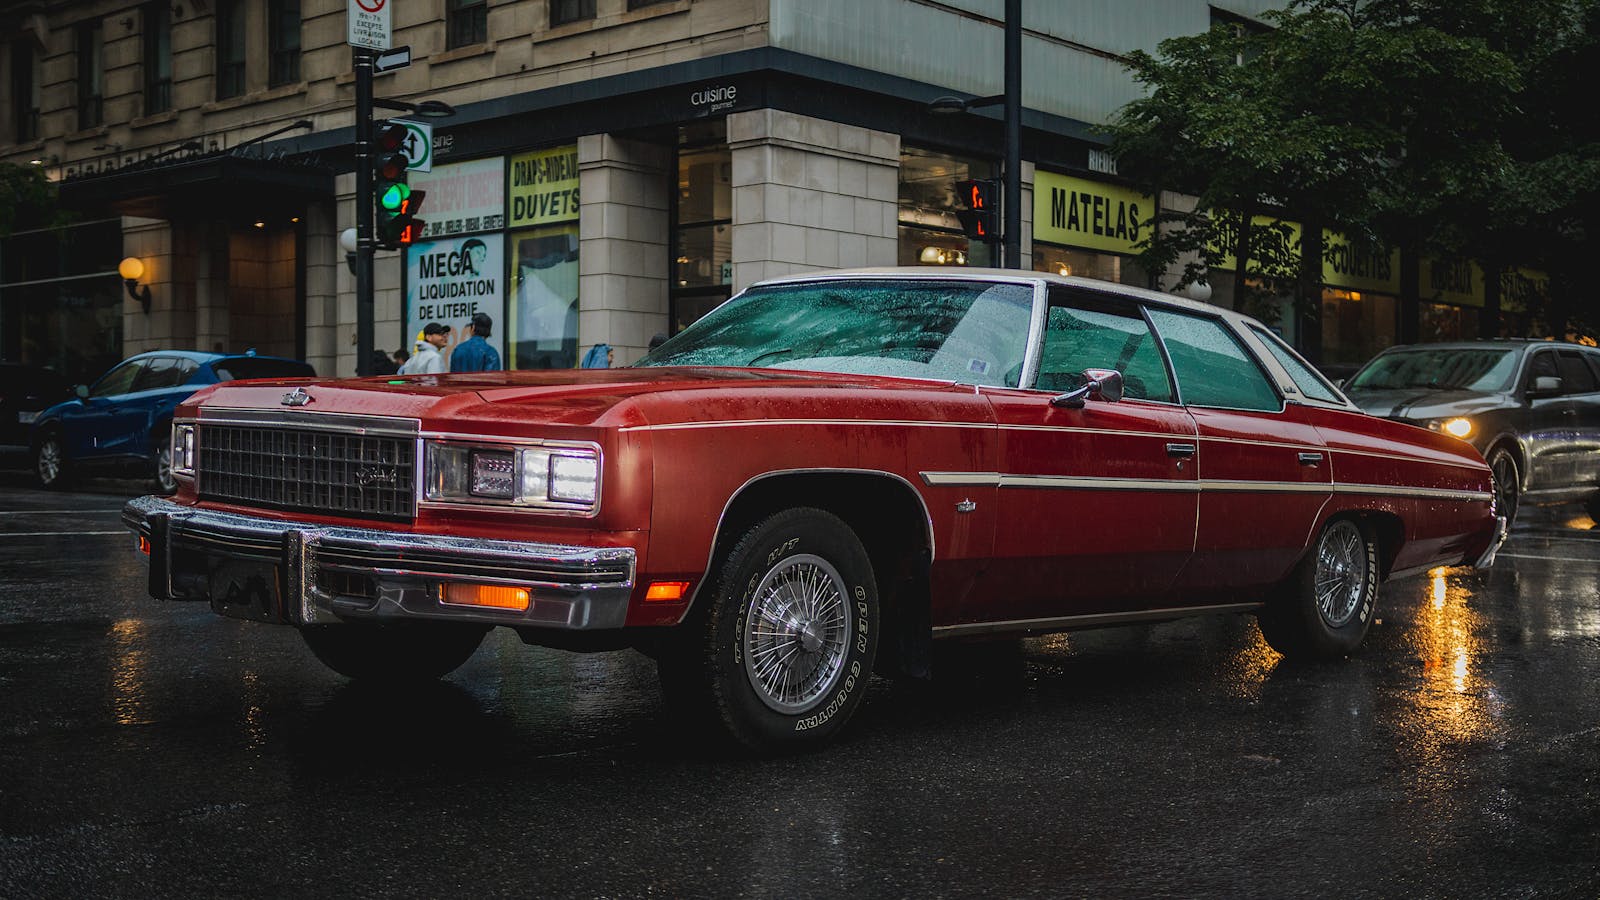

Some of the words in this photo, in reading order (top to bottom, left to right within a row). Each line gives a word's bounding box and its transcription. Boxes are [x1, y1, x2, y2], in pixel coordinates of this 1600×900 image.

[353, 28, 386, 39] LIVRAISON
[691, 85, 737, 105] cuisine
[433, 134, 454, 148] sine
[513, 152, 579, 187] DRAPS-RIDEAU
[514, 187, 580, 220] DUVETS
[1051, 187, 1139, 242] MATELAS
[419, 250, 474, 279] MEGA
[420, 279, 495, 300] LIQUIDATION
[419, 305, 433, 320] DE
[436, 302, 478, 319] LITERIE
[1360, 542, 1376, 623] HERCULES
[734, 572, 759, 664] TOYO
[854, 585, 869, 654] OPEN
[795, 660, 862, 731] COUNTRY
